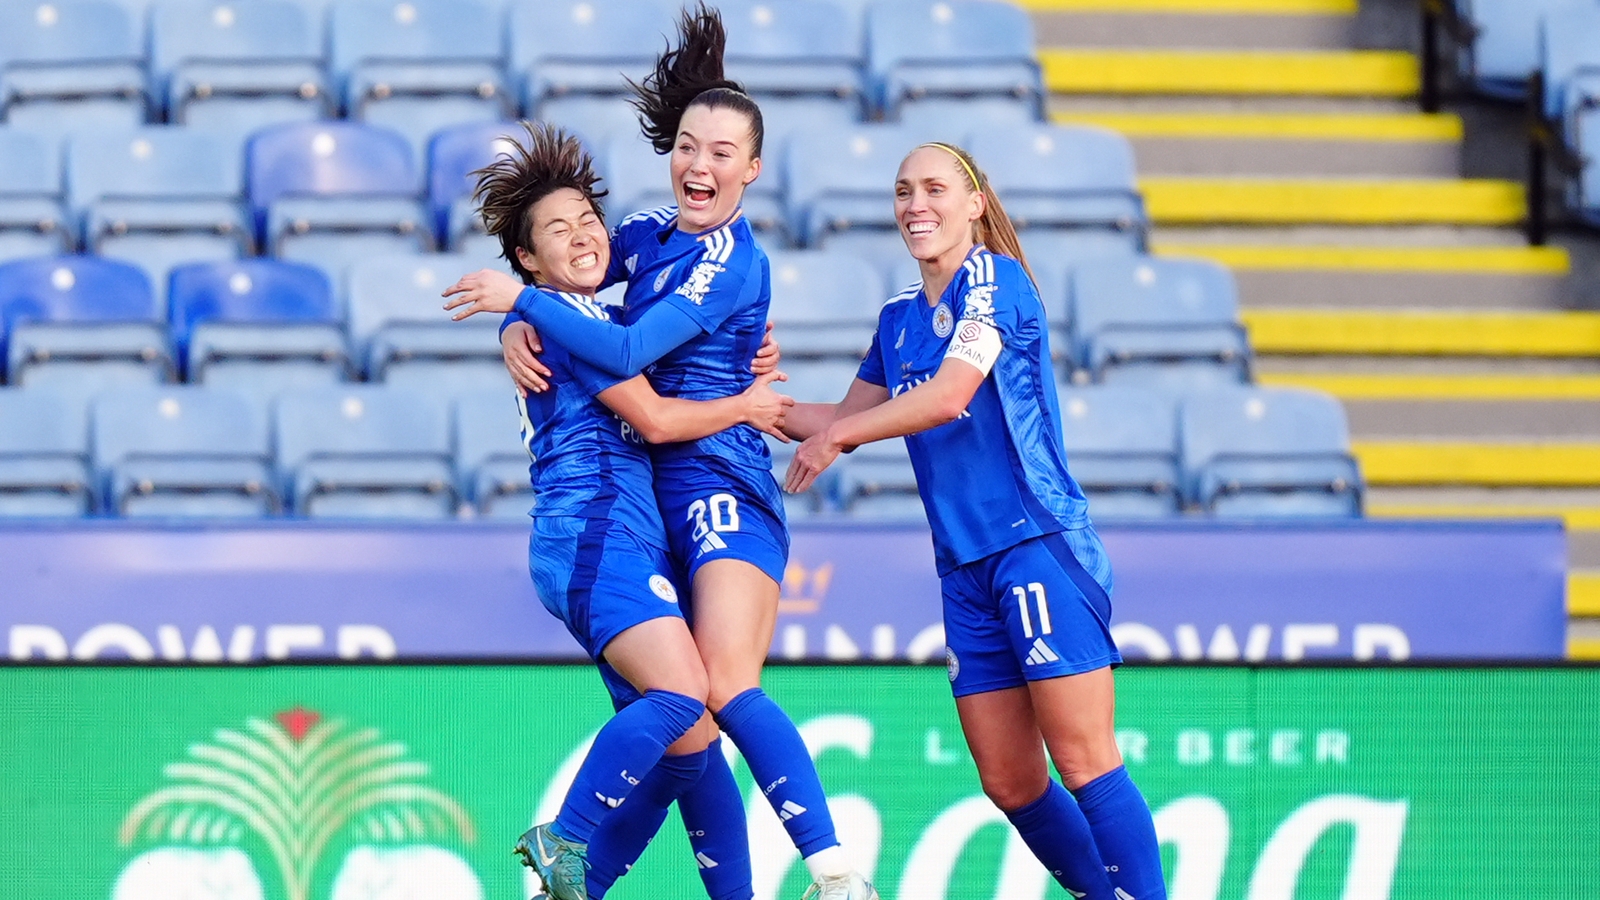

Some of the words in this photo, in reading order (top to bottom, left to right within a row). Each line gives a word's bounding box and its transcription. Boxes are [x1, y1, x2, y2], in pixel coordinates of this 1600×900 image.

[949, 343, 985, 364] APTAIN
[1012, 582, 1052, 638] 11
[1176, 727, 1348, 765] BEER
